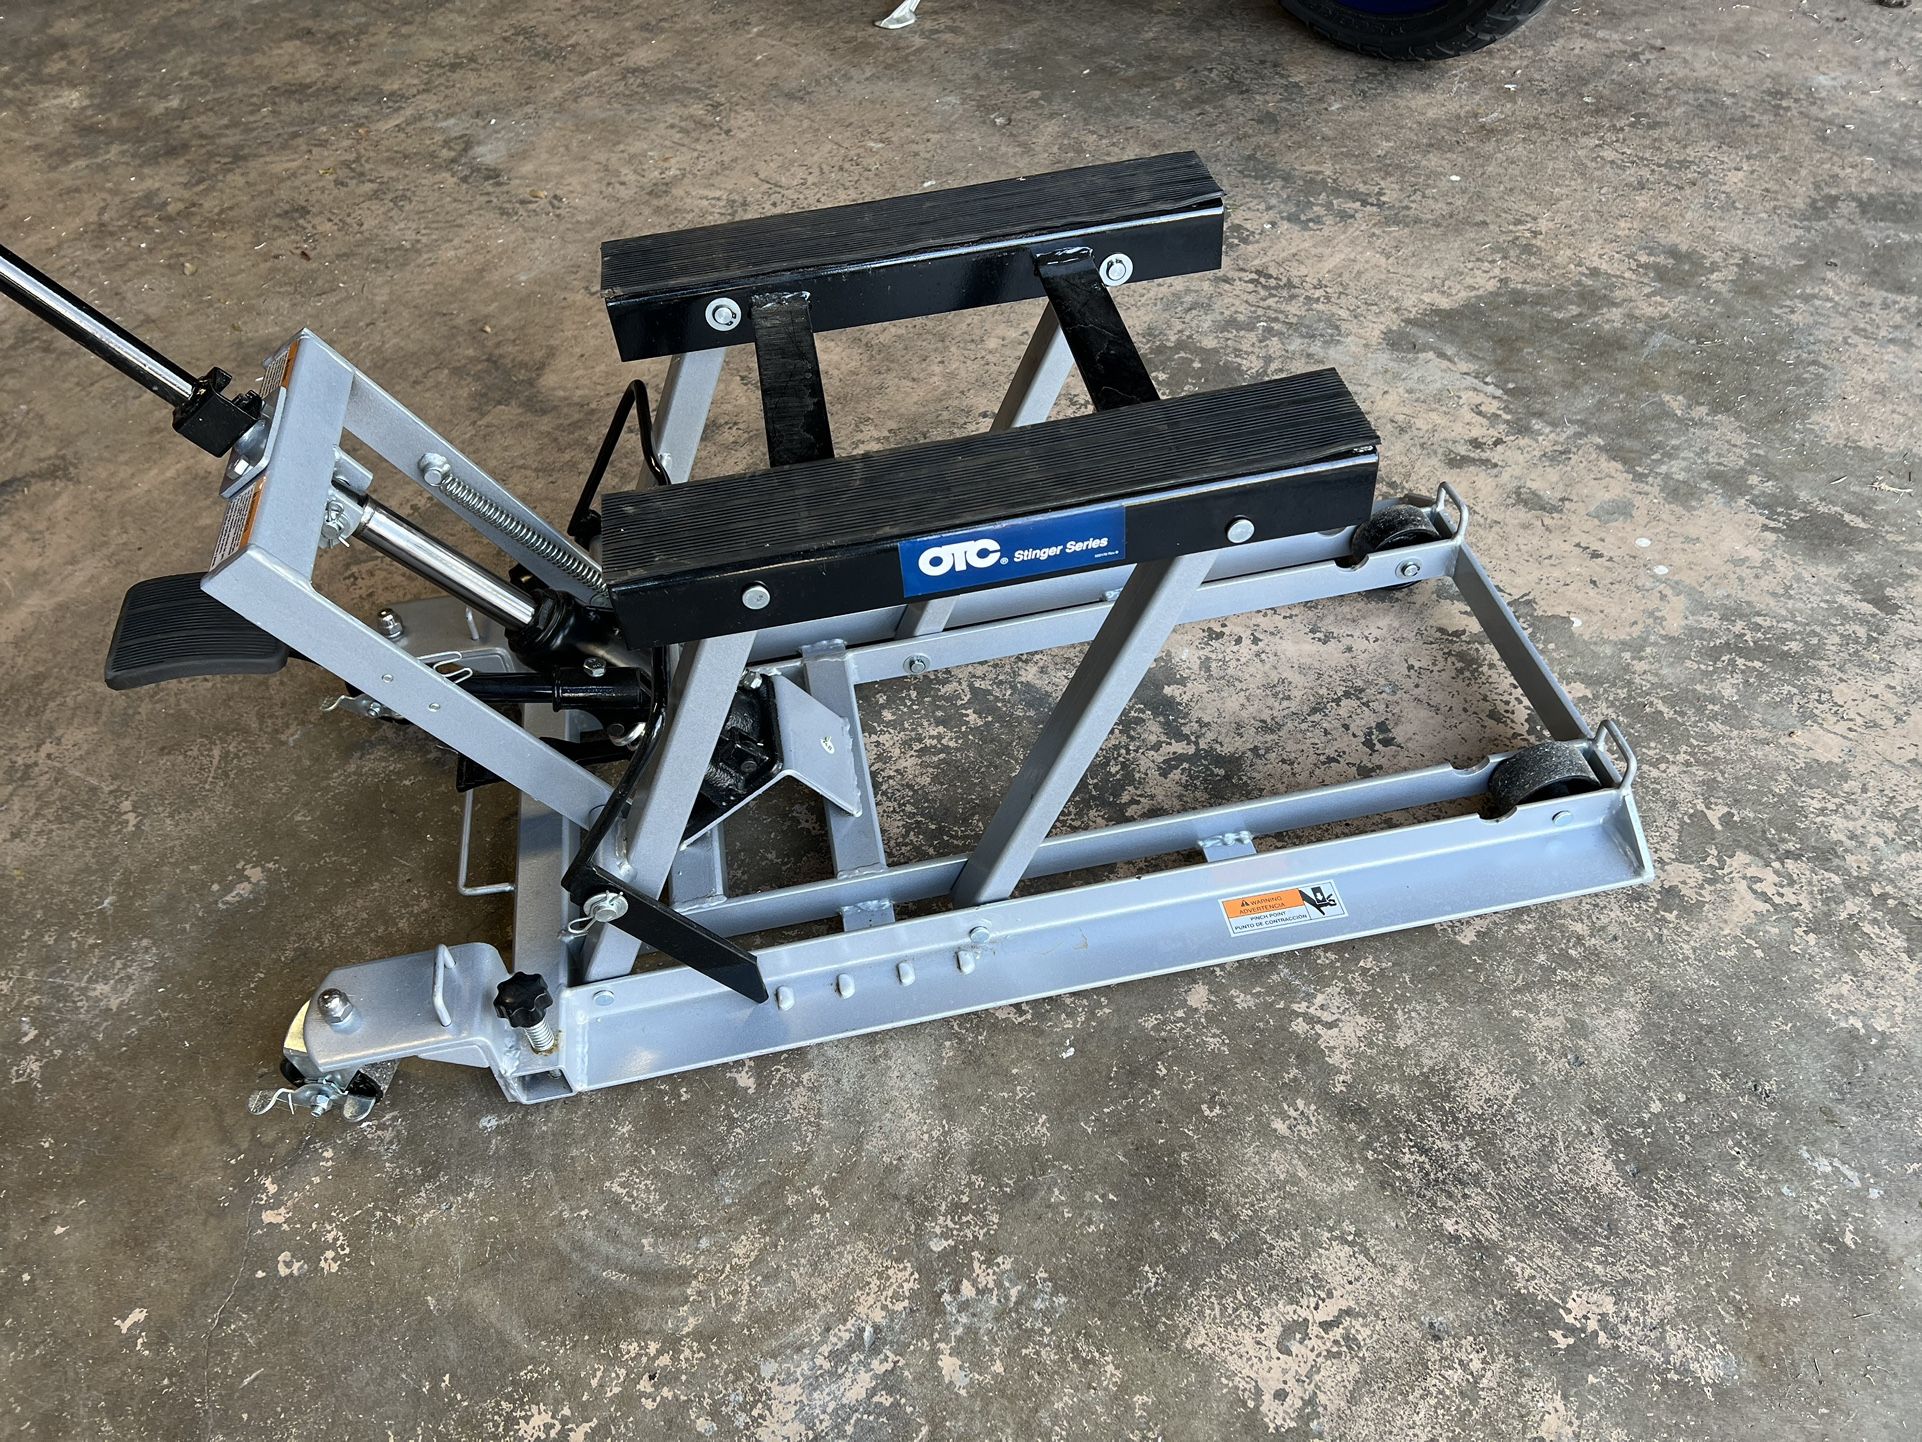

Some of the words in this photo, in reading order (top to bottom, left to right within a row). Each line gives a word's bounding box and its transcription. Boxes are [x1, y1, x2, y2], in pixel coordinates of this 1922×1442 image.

[918, 538, 1001, 576] OTC
[1013, 545, 1063, 562] Stinger
[1065, 537, 1108, 553] Series
[1239, 902, 1285, 914] ADVERTENCIA
[1250, 895, 1282, 905] WARNING
[1234, 923, 1255, 931] PUNTO
[1264, 914, 1308, 925] CONTRACCIÓN
